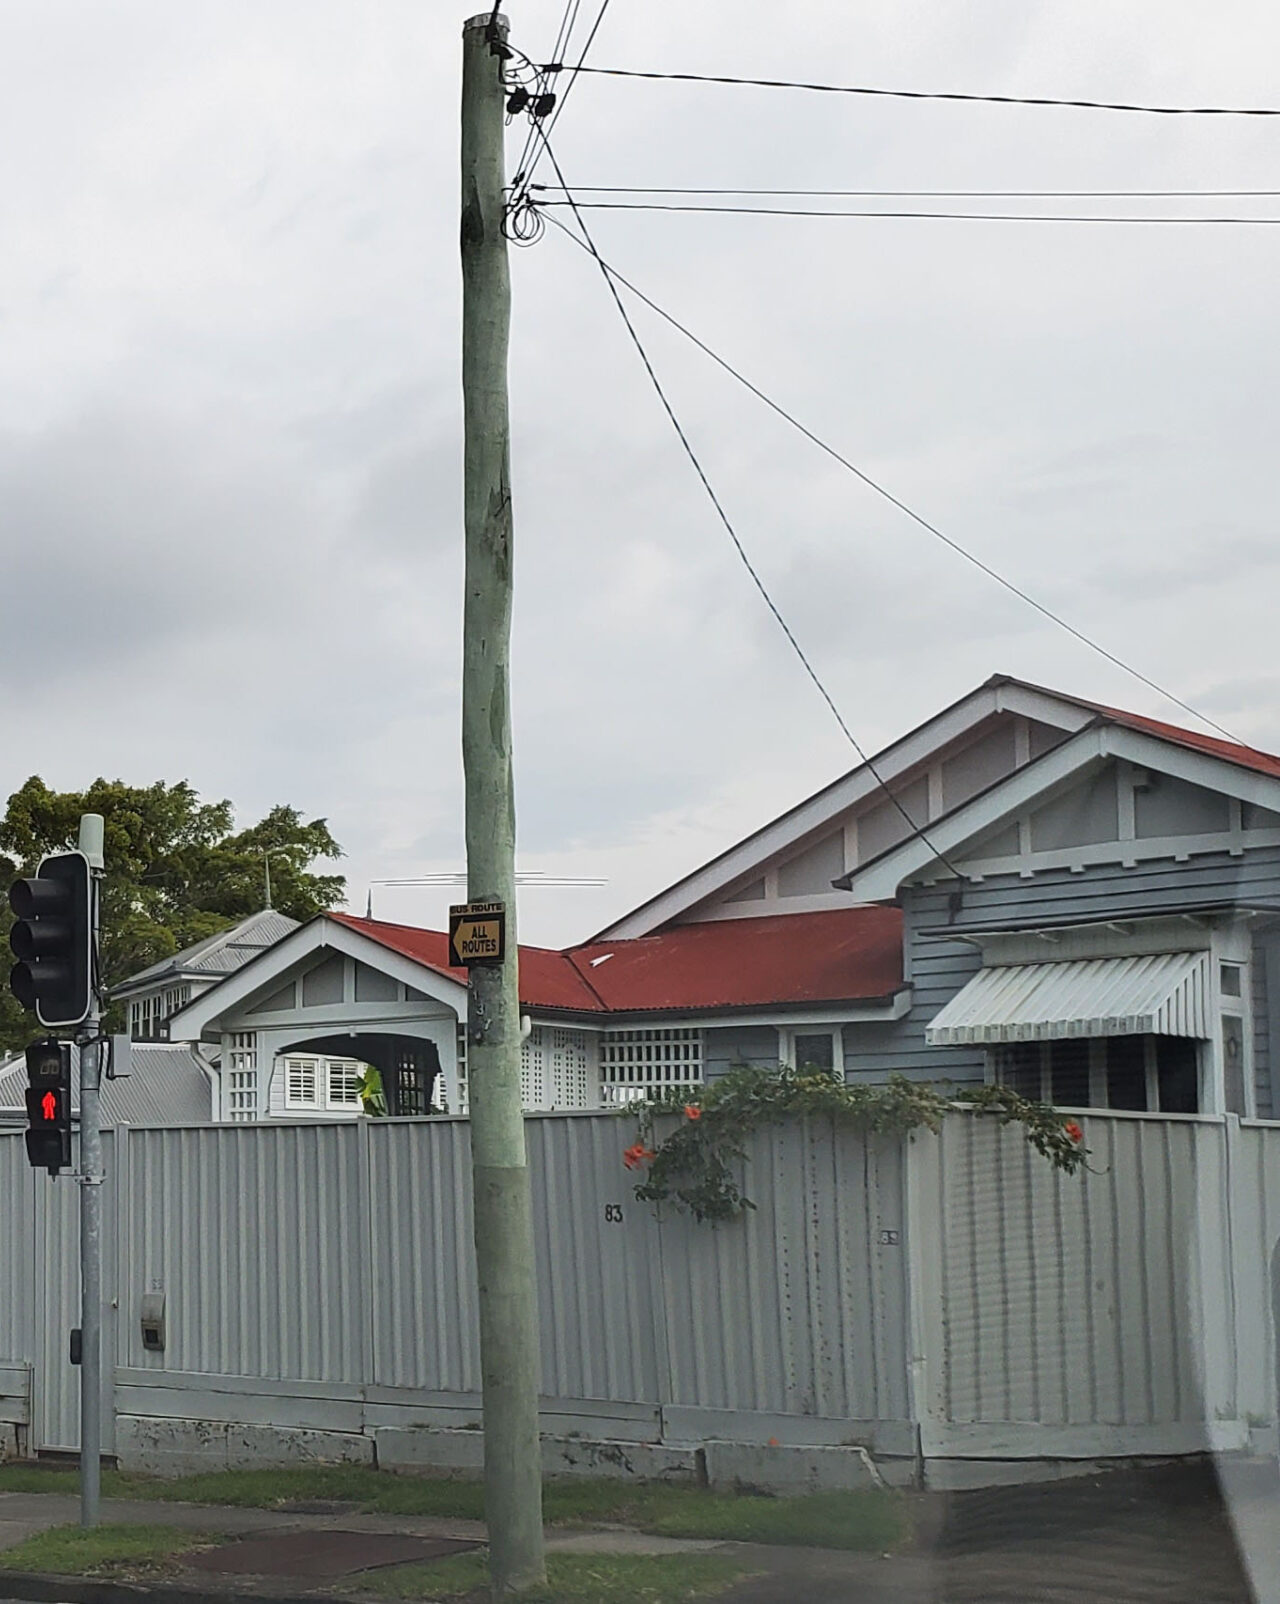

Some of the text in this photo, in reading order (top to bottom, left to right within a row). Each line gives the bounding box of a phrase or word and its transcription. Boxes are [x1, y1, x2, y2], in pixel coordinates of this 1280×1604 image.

[471, 903, 502, 913] ROUTE
[471, 925, 488, 939] ALL
[462, 939, 496, 953] ROUTES
[605, 1204, 623, 1223] 83
